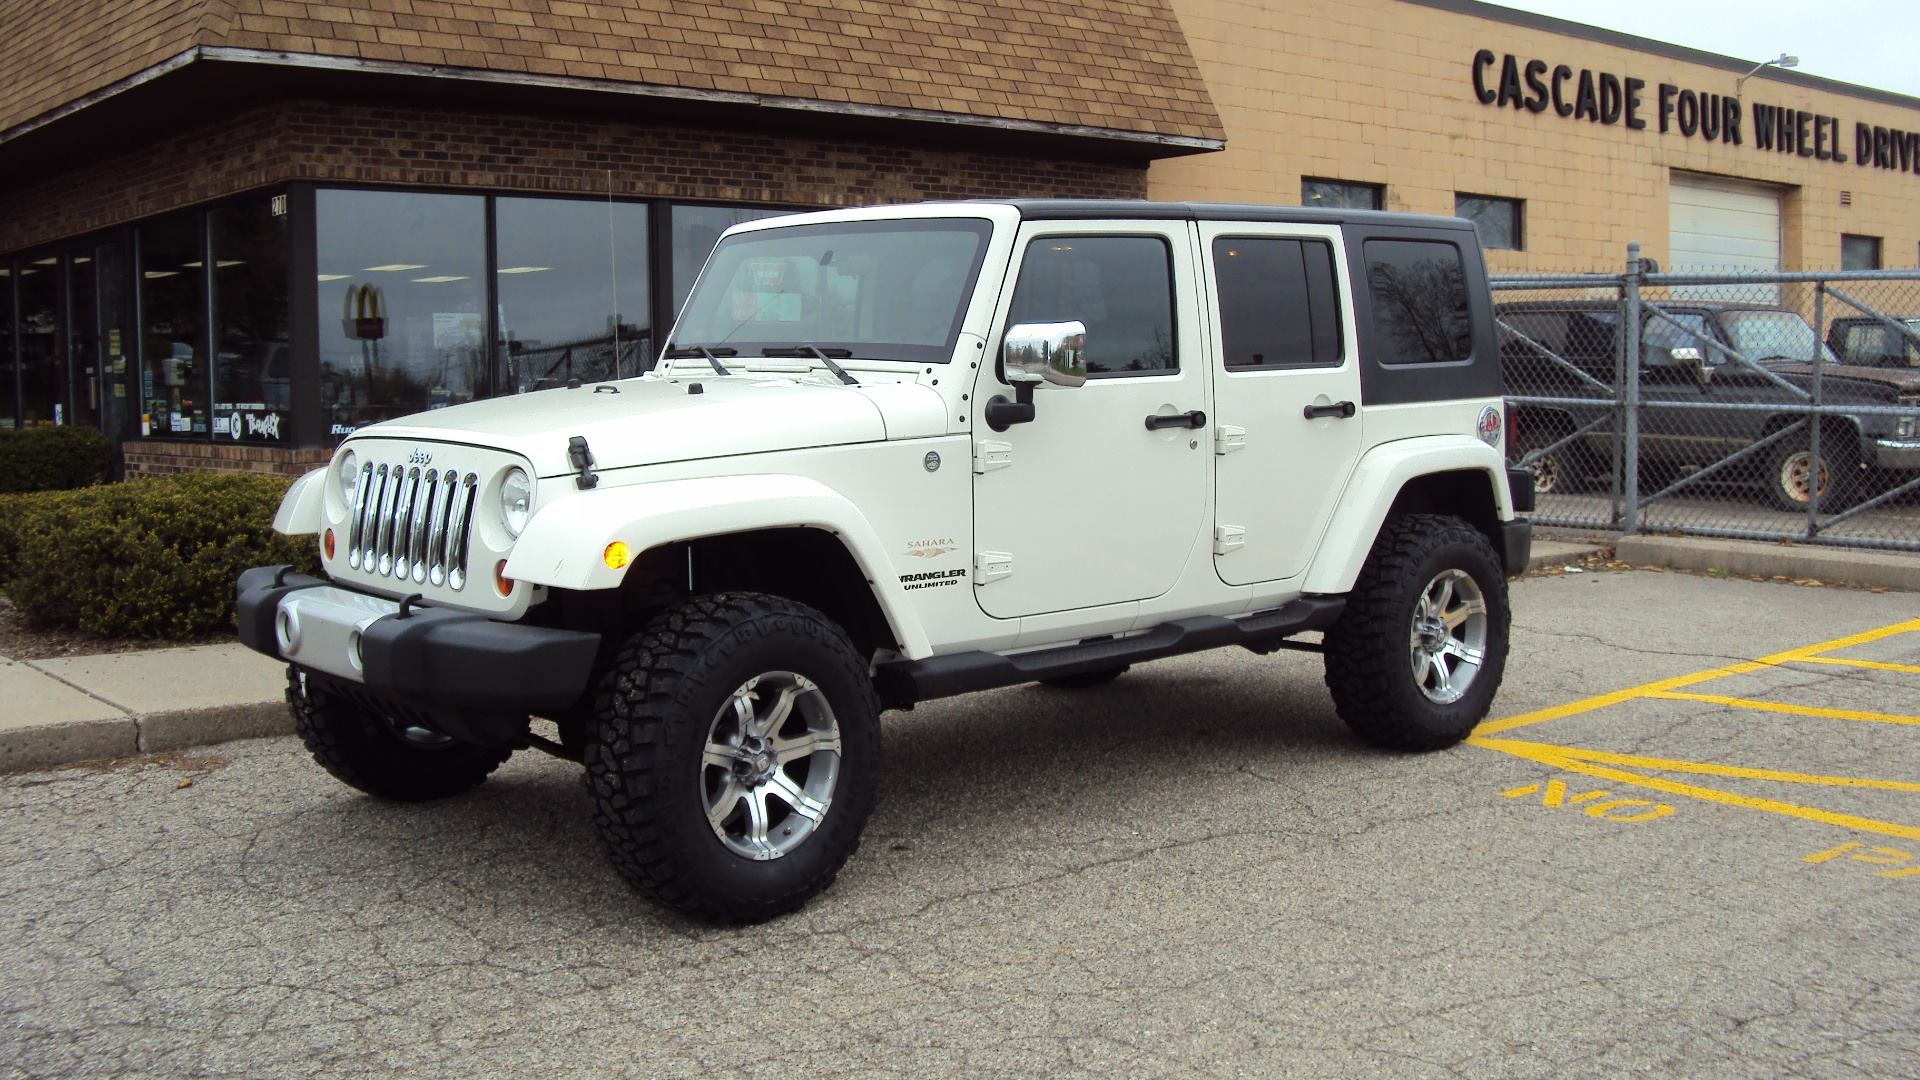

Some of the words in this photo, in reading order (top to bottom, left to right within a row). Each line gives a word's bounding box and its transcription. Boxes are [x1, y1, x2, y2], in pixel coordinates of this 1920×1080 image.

[1472, 49, 1646, 130] CASCADE
[1658, 83, 1742, 145] FOUR
[1752, 102, 1847, 163] WHEEL
[408, 447, 432, 467] Jeep
[907, 538, 954, 548] SAHARA
[904, 580, 957, 590] UNLIMITED
[1500, 780, 1676, 823] NO
